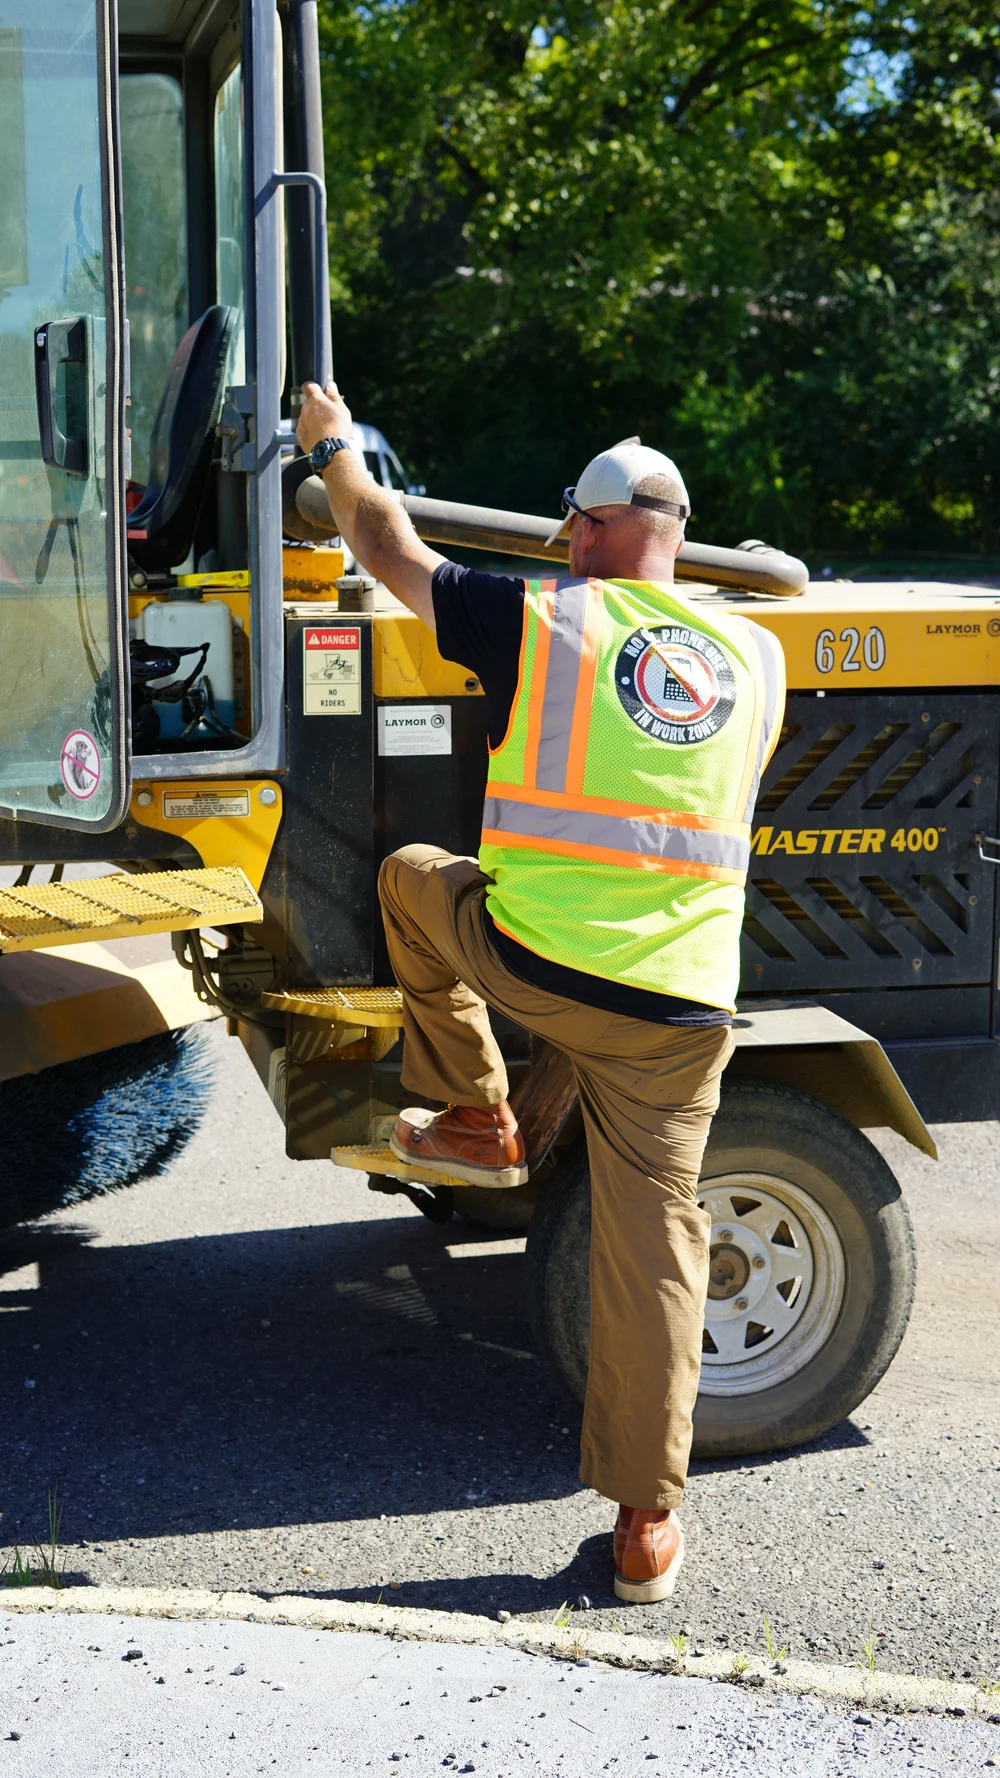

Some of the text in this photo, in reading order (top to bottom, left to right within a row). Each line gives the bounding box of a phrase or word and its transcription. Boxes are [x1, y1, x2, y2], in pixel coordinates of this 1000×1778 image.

[926, 624, 981, 634] LAYMOR
[321, 635, 356, 645] DANGER
[624, 636, 645, 658] NO
[661, 628, 707, 653] PHONE
[704, 644, 729, 673] USE
[815, 626, 886, 674] 620
[320, 699, 346, 707] RIDERS
[385, 718, 427, 727] LAYMOR
[633, 708, 718, 742] IN WORK ZONE
